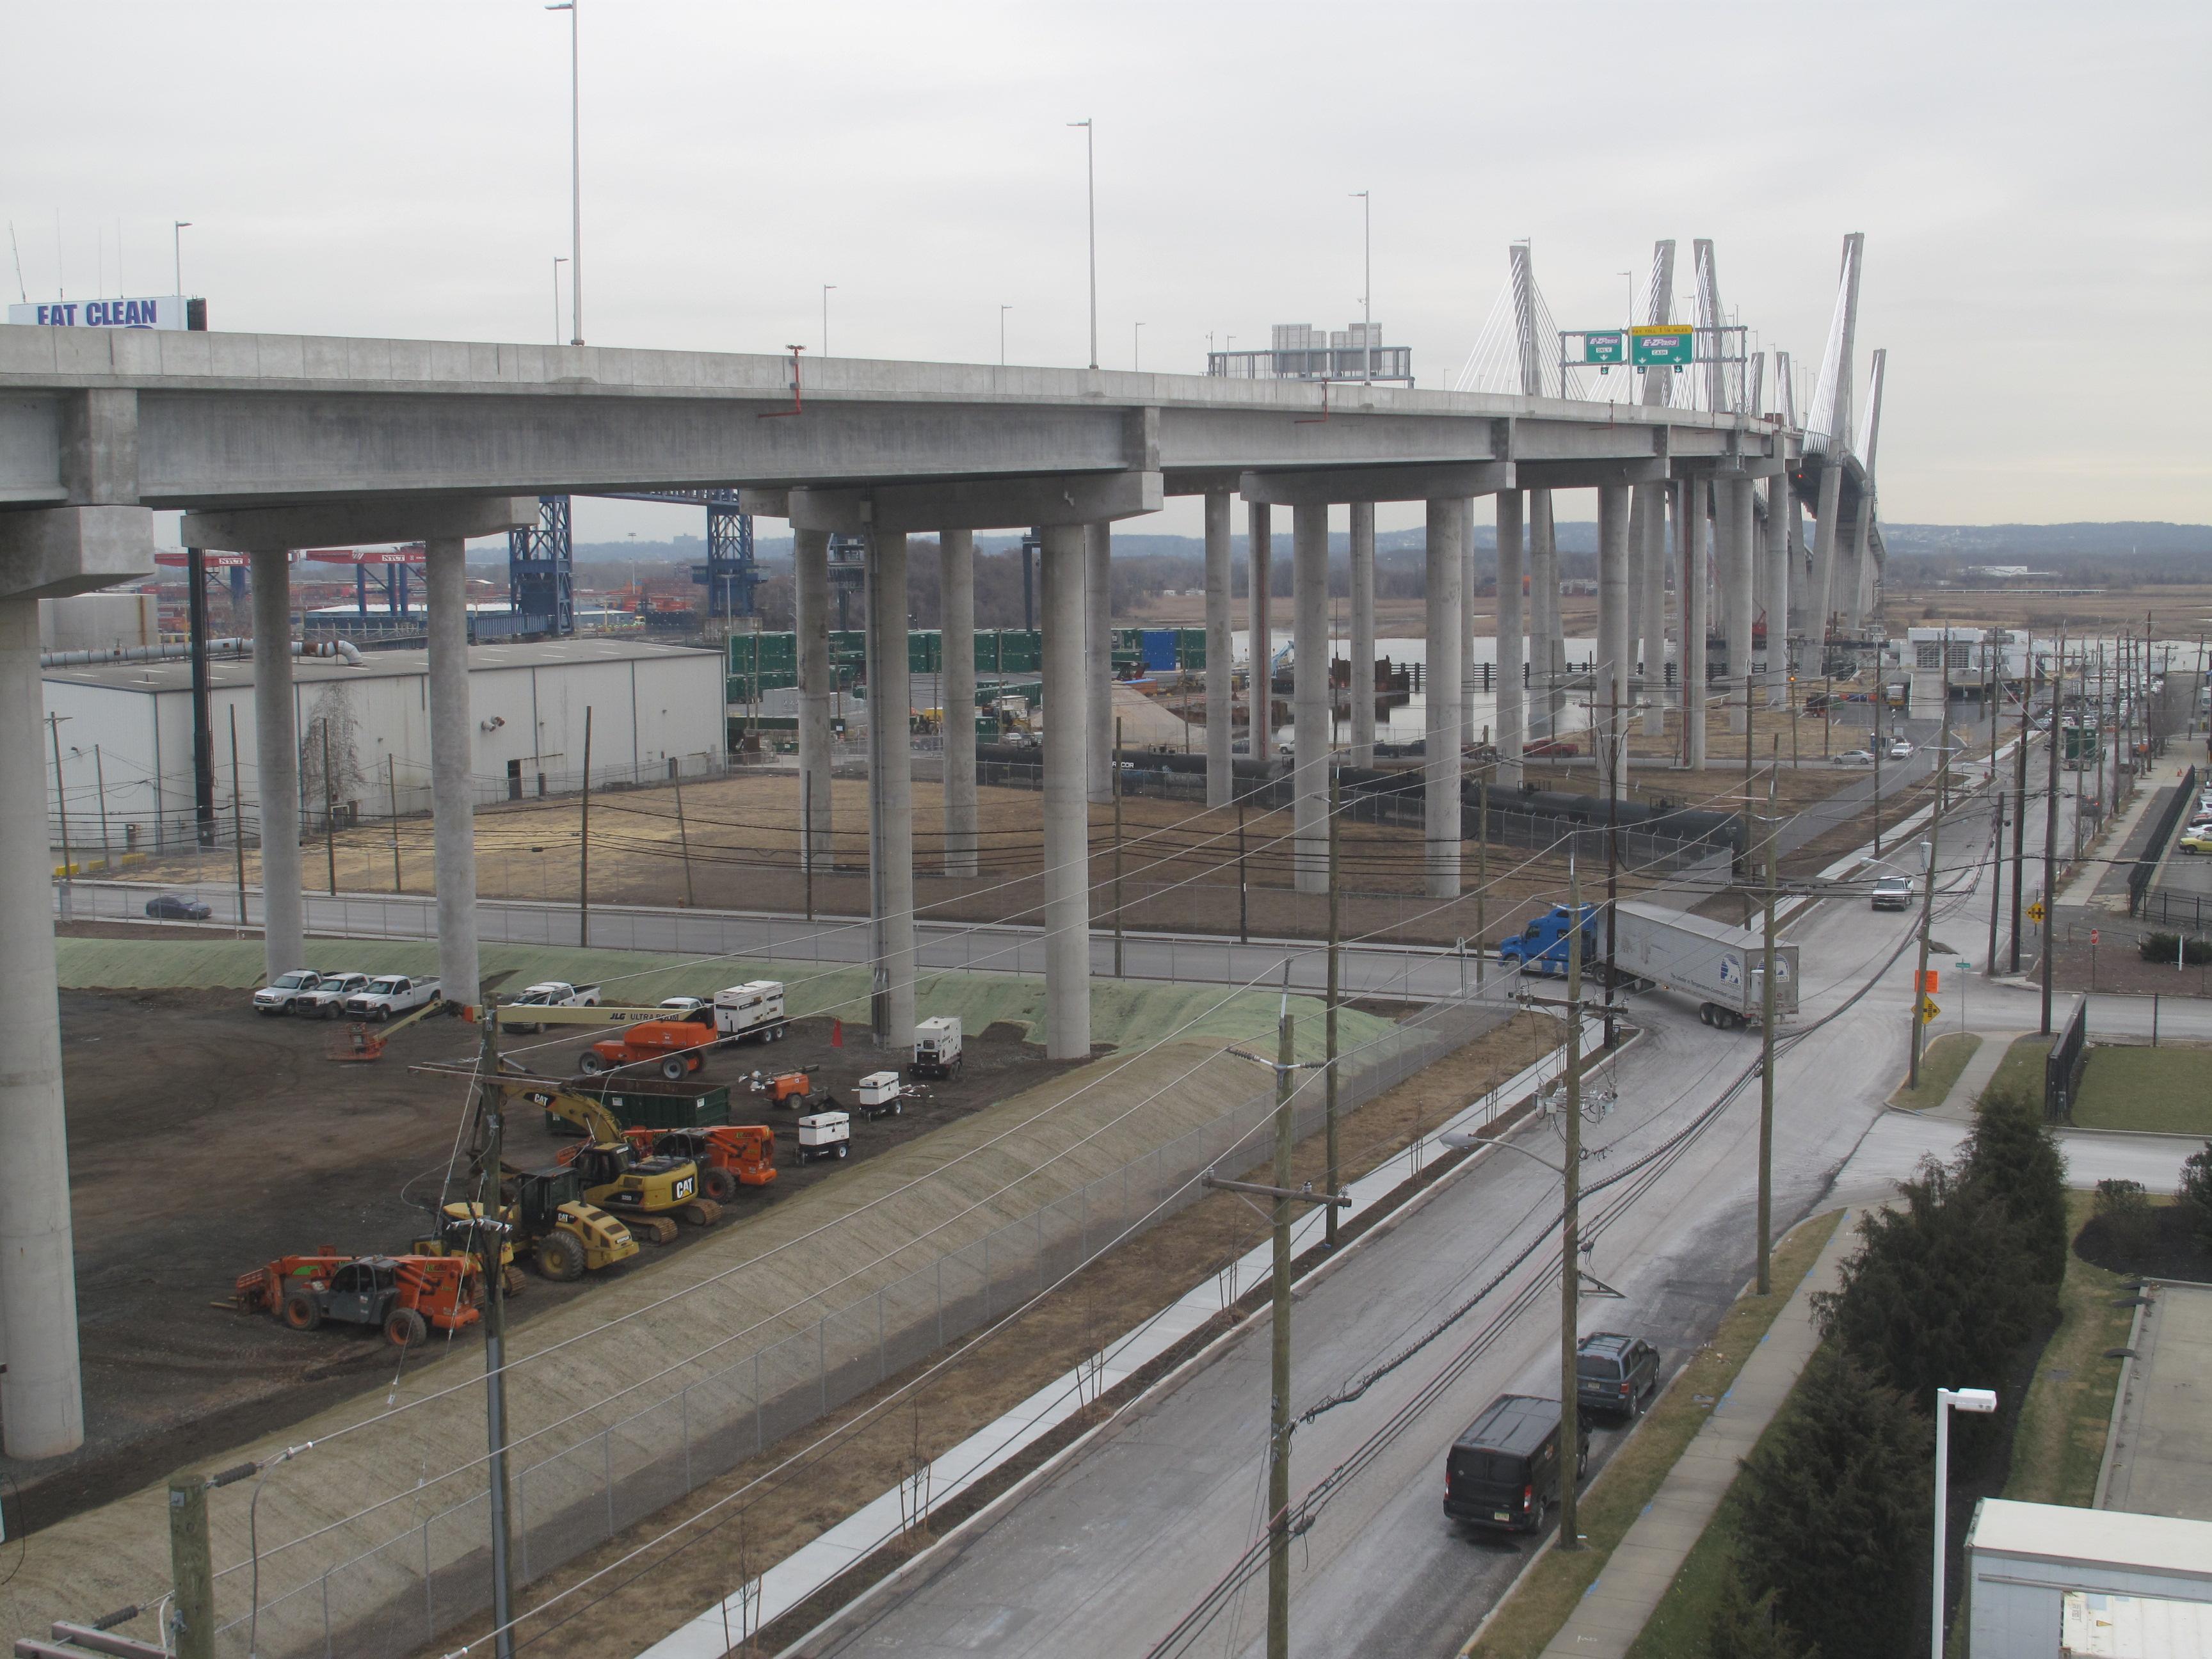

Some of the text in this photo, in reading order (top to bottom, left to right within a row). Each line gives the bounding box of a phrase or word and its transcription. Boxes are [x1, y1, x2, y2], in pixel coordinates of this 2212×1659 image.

[37, 300, 157, 326] EAT CLEAN
[534, 1093, 549, 1107] CAT
[676, 1177, 693, 1199] CAT
[557, 1213, 569, 1222] CAT
